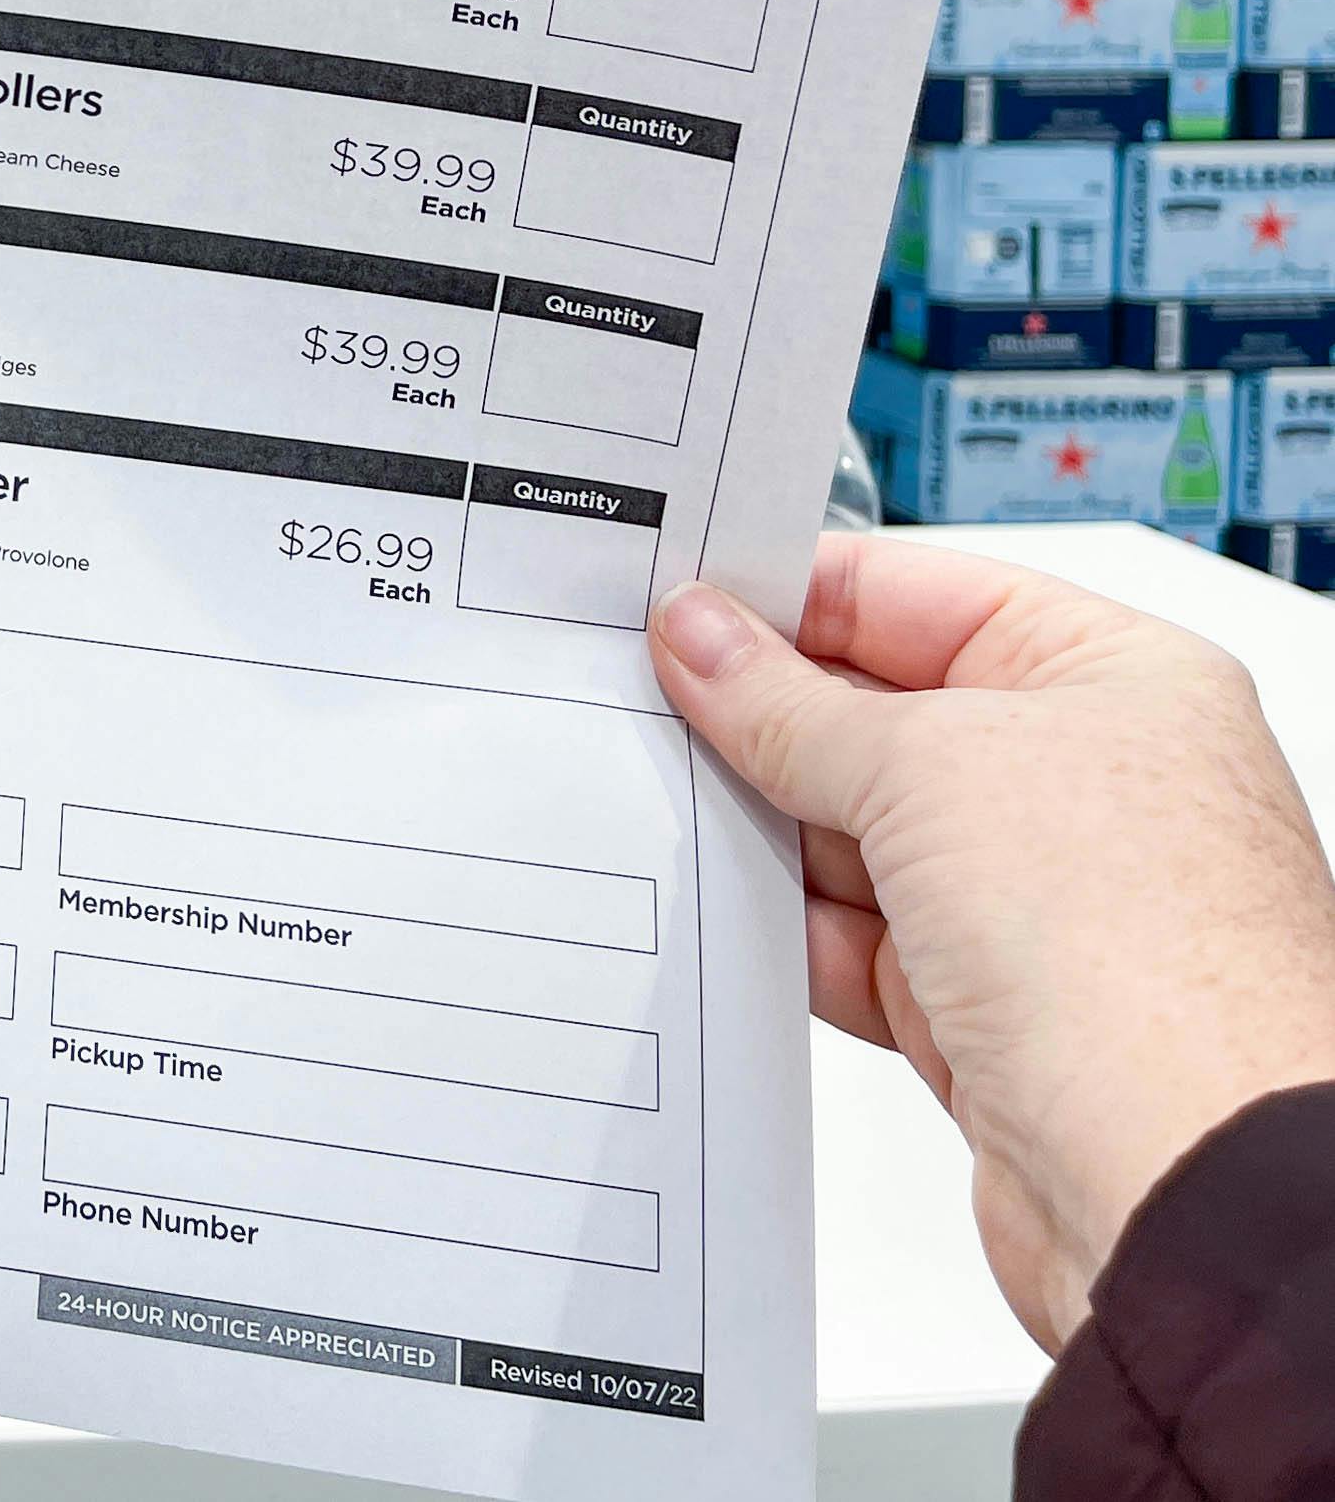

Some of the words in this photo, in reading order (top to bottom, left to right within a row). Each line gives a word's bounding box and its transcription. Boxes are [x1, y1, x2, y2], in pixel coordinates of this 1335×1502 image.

[451, 2, 520, 33] Each
[578, 105, 694, 147] Quantity
[45, 153, 121, 178] Cheese
[330, 136, 497, 194] $39.99
[420, 195, 487, 224] Each
[544, 293, 656, 334] Quantity
[300, 324, 461, 379] $39.99
[391, 382, 457, 410] Each
[513, 480, 622, 516] Quantity
[278, 518, 433, 573] $26.99
[368, 576, 431, 605] Each
[58, 887, 229, 934] Membership
[238, 912, 353, 947] Number
[52, 1037, 144, 1075] Pickup
[153, 1051, 224, 1083] Time
[42, 1191, 133, 1228] Phone
[141, 1206, 259, 1246] Number
[57, 1292, 165, 1328] 24-HOUR
[171, 1309, 261, 1342] NOTICE
[267, 1325, 437, 1370] APPRECIATED
[490, 1358, 583, 1393] Revised
[590, 1373, 698, 1410] 10/07/22
